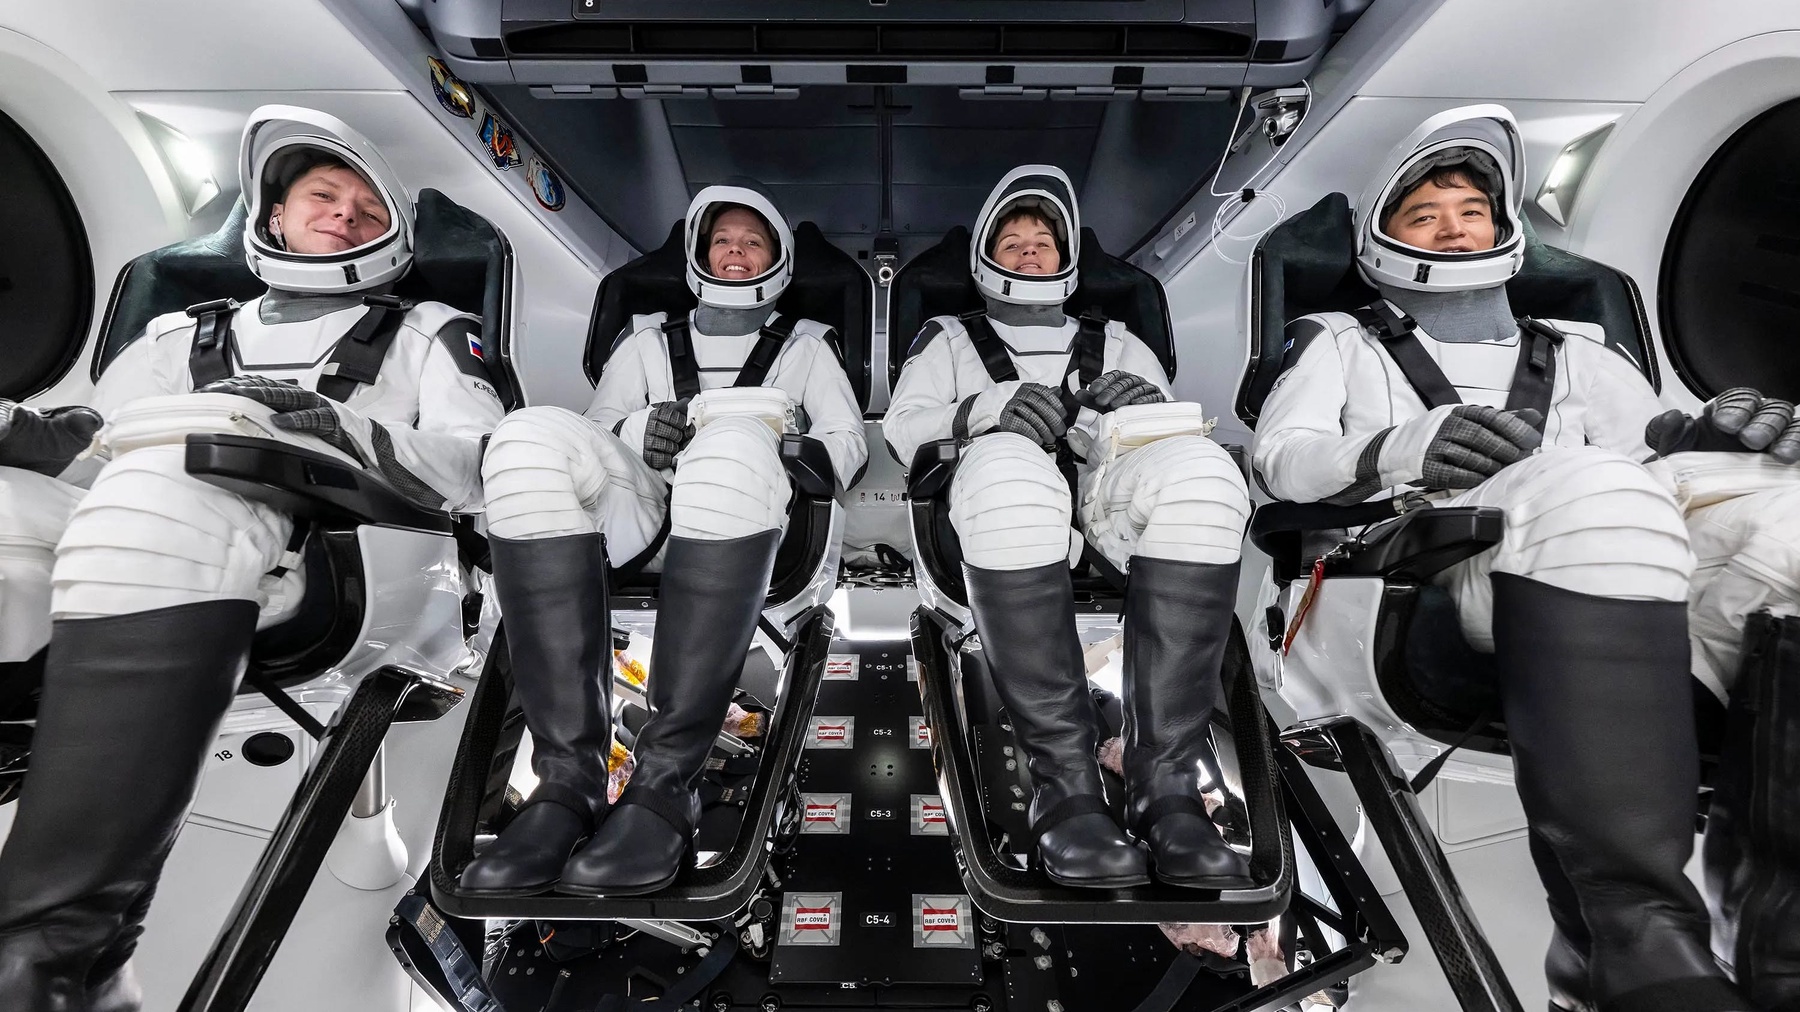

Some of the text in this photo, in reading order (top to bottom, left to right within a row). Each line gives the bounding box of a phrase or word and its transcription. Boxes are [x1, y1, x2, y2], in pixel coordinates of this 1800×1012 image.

[874, 492, 885, 501] 14
[214, 749, 233, 761] 18
[870, 810, 891, 818] C5-3
[866, 915, 890, 924] C5-4
